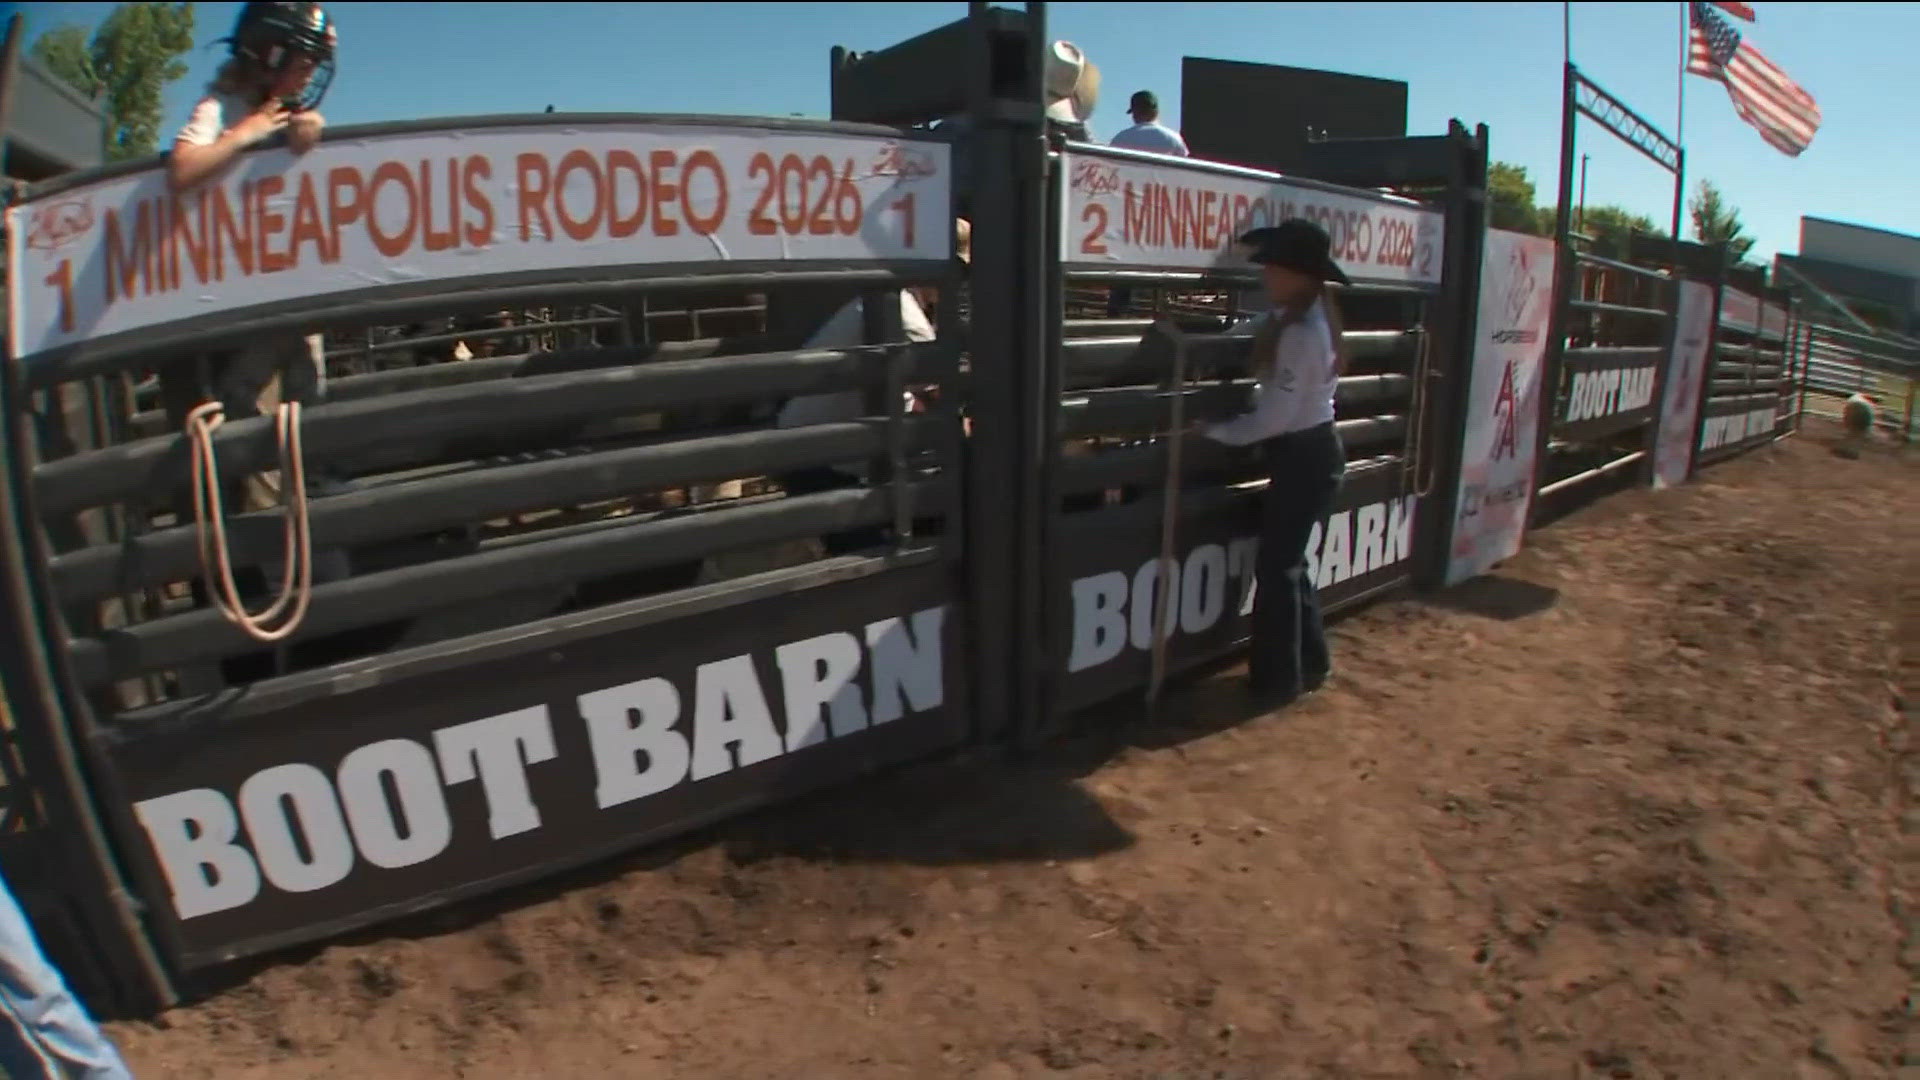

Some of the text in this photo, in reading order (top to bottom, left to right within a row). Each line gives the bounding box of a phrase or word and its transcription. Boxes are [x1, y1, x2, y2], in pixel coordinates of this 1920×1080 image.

[104, 153, 495, 302] MINNEAPOLIS
[516, 148, 729, 241] RODEO
[747, 152, 863, 237] 2026
[889, 192, 916, 249] 1
[1081, 203, 1109, 254] 2
[1376, 215, 1415, 267] 2026
[43, 258, 75, 334] 1
[1566, 369, 1621, 422] BOOT
[134, 606, 947, 920] BOOT BARN
